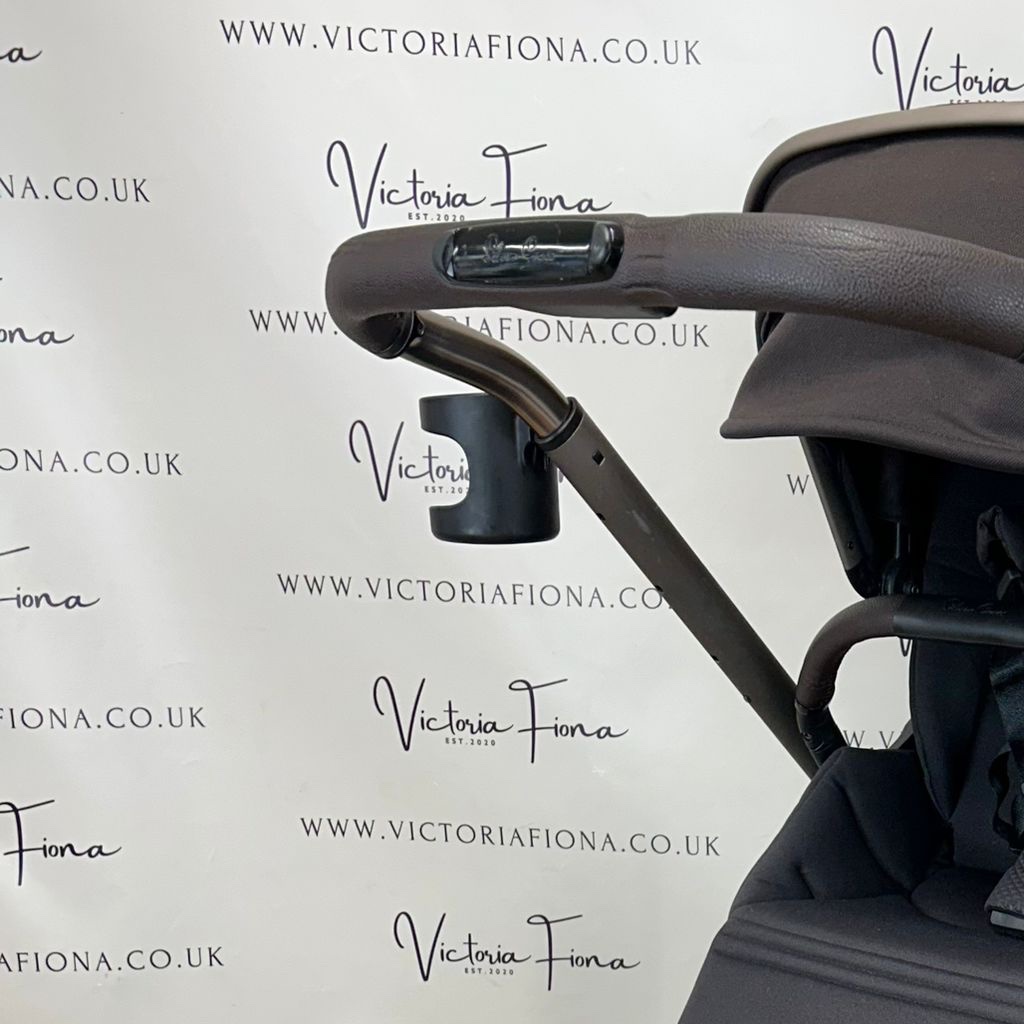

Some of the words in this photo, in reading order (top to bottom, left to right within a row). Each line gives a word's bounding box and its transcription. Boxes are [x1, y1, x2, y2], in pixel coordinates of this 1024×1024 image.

[219, 19, 701, 65] WWW.VICTORIAFIONA.CO.UK
[326, 140, 486, 229] Victoria
[481, 143, 612, 218] Fiona
[408, 212, 466, 222] EST.2020
[424, 485, 469, 495] EST.20
[277, 574, 672, 609] WWW.VICTORIAFIONA.CO.
[0, 707, 206, 729] IONA.CO.UK
[373, 676, 513, 752] Victoria
[509, 678, 629, 764] Fiona
[445, 737, 496, 746] EST.2020
[300, 818, 720, 856] WWW.VICTORIAFIONA.CO.UK
[393, 911, 531, 982] Victoria
[527, 914, 640, 991] Fiona
[465, 967, 513, 975] EST.2020
